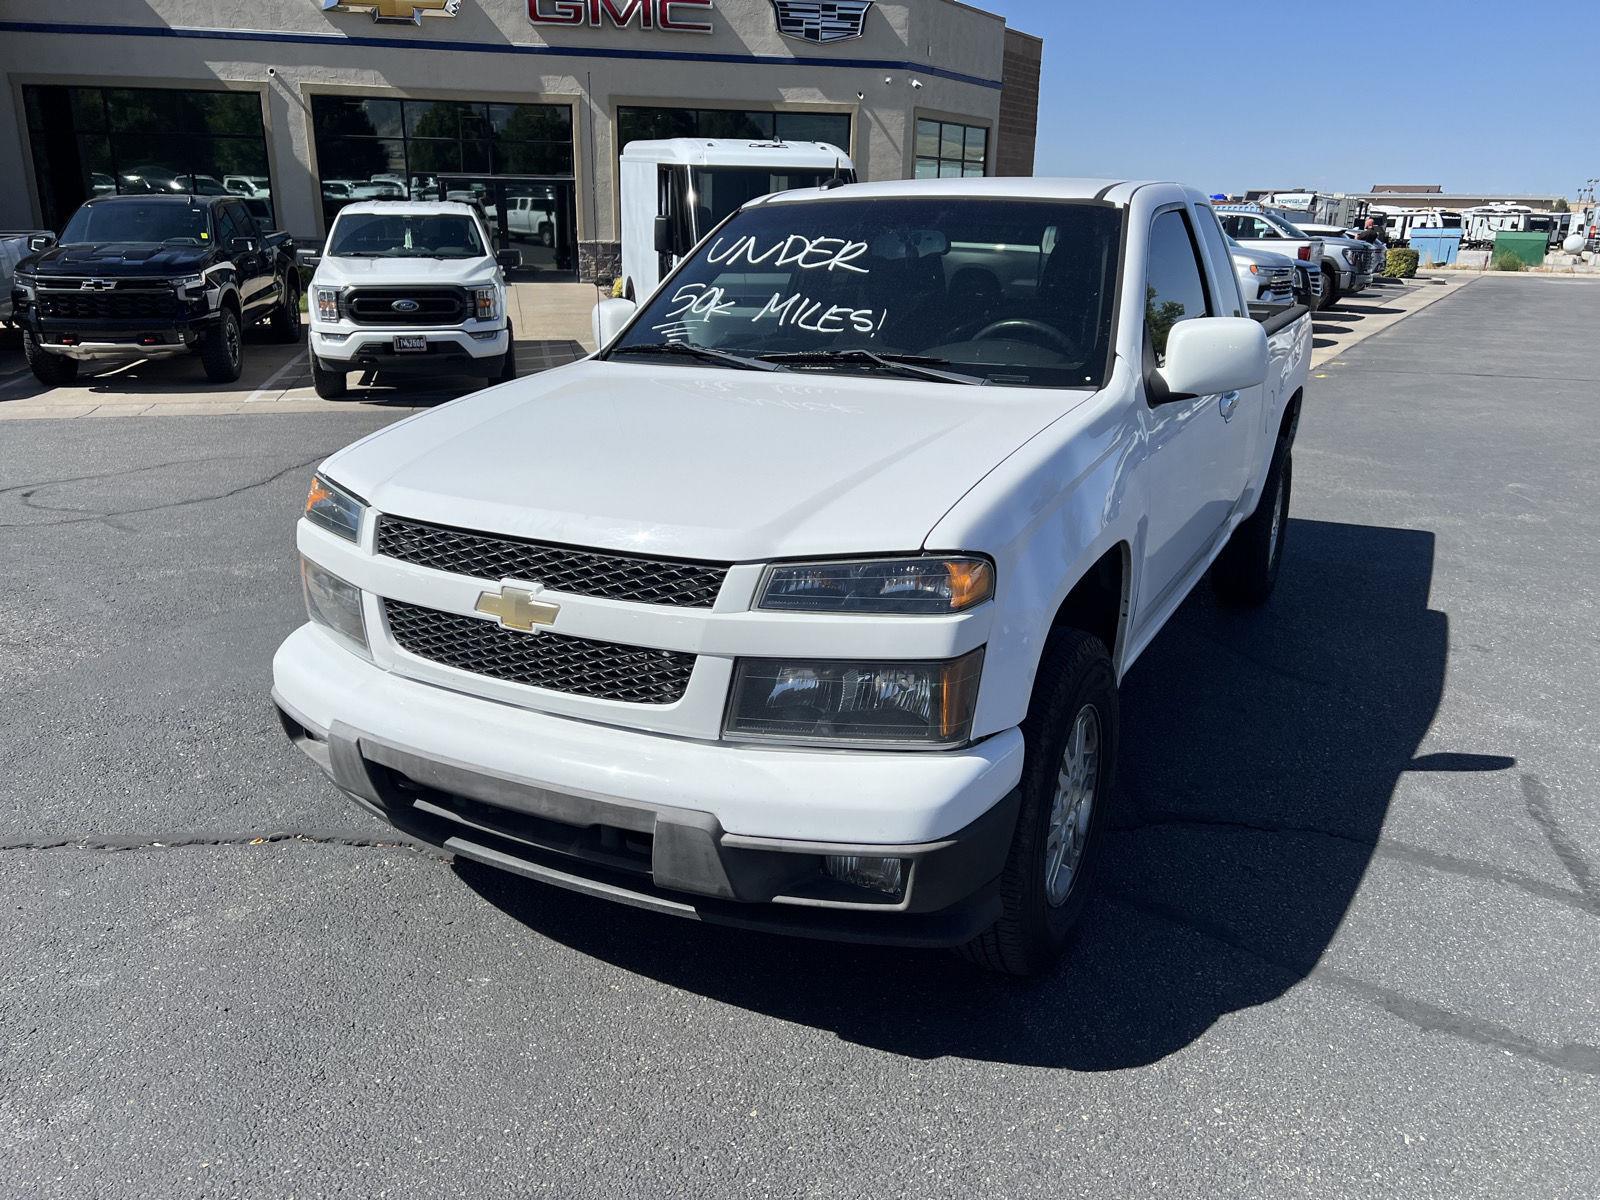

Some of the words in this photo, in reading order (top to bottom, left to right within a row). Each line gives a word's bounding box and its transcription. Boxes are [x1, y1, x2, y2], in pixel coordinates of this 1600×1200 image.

[528, 0, 714, 34] GMC
[706, 234, 870, 273] UNDER
[751, 292, 887, 338] MILES!
